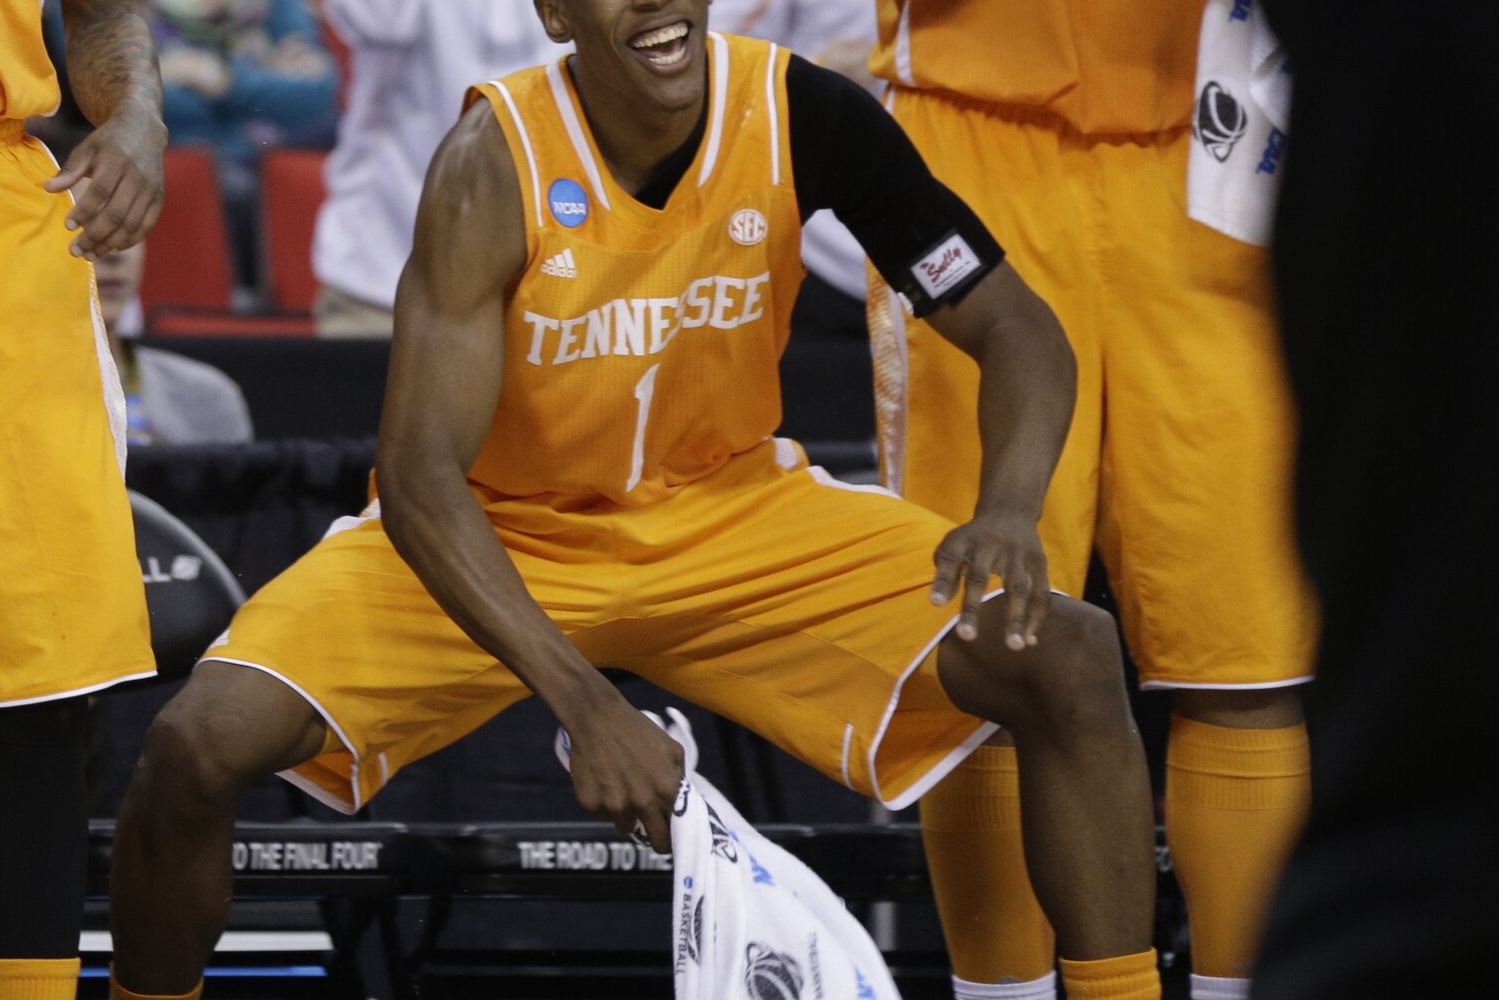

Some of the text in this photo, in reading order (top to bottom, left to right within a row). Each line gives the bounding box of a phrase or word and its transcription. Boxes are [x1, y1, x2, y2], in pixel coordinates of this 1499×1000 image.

[553, 201, 587, 216] NCAA
[732, 209, 767, 244] SEC
[625, 362, 661, 493] 1
[249, 842, 283, 870] THE
[283, 842, 330, 870] FINAL
[331, 841, 380, 870] FOUR
[517, 841, 555, 869] THE
[556, 841, 609, 870] ROAD
[609, 842, 636, 870] TO
[674, 893, 692, 975] BASKETBALL
